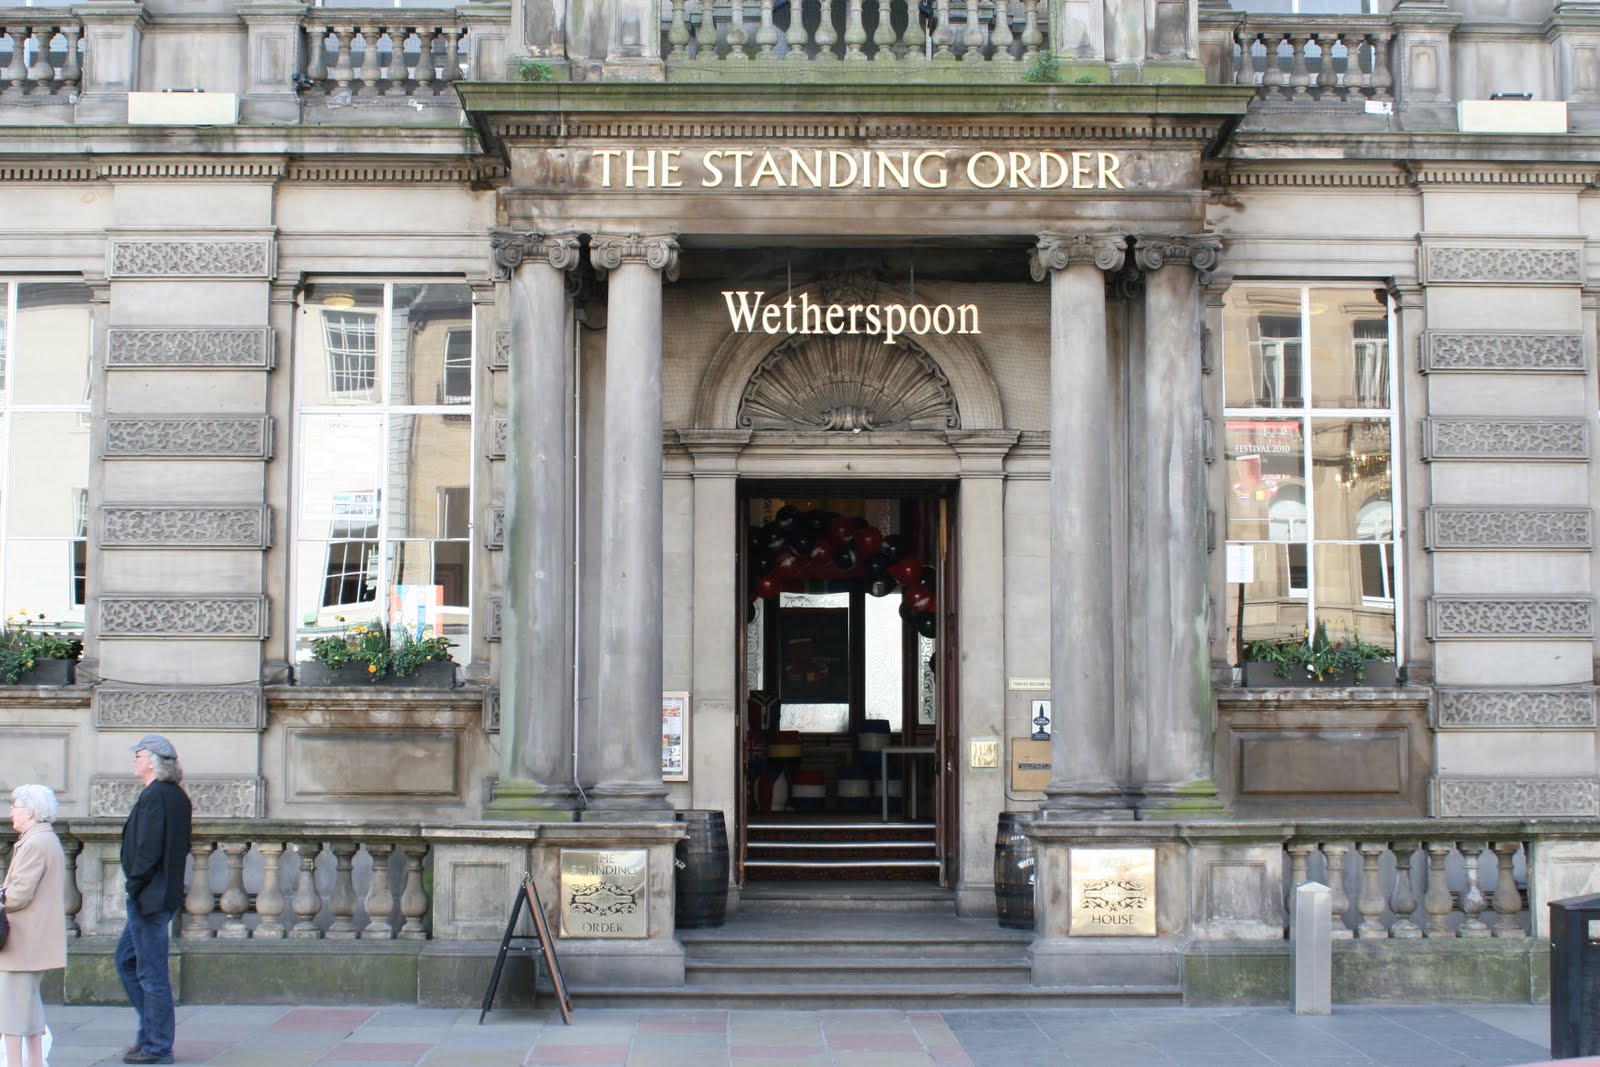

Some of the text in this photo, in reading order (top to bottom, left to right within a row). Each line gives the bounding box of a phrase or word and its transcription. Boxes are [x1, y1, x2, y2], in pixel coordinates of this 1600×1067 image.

[592, 149, 1126, 190] THE STANDING ORDER
[721, 290, 981, 345] Wetherspoon
[1235, 444, 1291, 453] FESTIVAL 2010
[592, 853, 616, 864] THE
[571, 865, 637, 876] STANDING
[1091, 914, 1135, 925] HOUSE
[581, 922, 624, 933] ORDER
